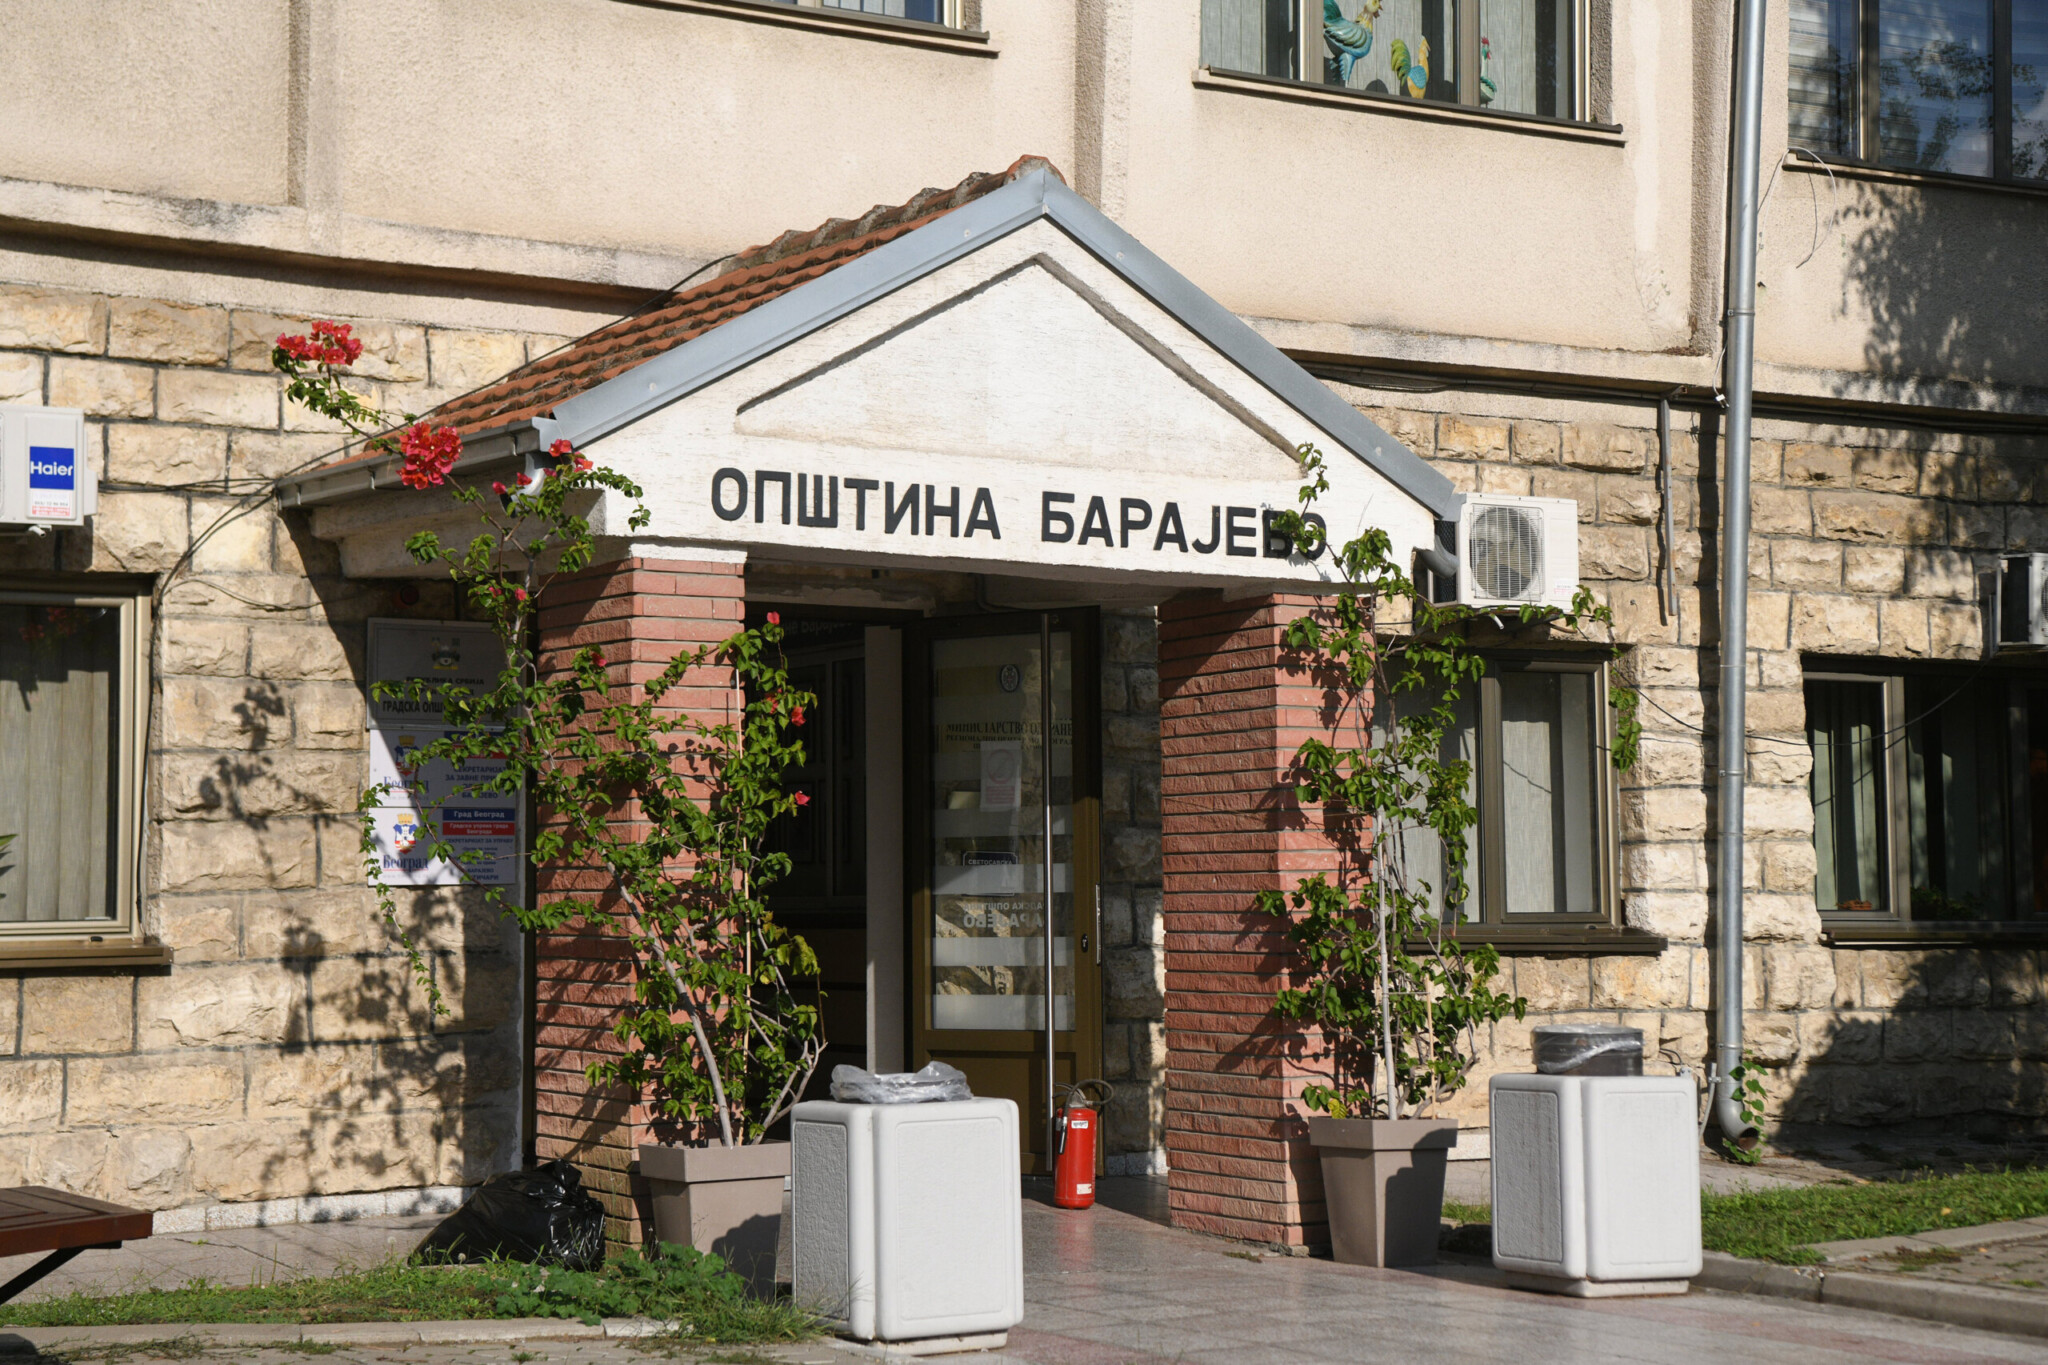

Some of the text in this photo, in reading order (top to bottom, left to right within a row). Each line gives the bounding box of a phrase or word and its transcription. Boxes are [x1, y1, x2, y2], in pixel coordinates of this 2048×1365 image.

[30, 460, 73, 476] Haier
[711, 466, 1326, 561] ОПШТИНА БАРАЈЕВО
[382, 701, 420, 714] ГРАДСКА
[454, 811, 505, 819] Град Београд
[383, 854, 430, 873] Београд
